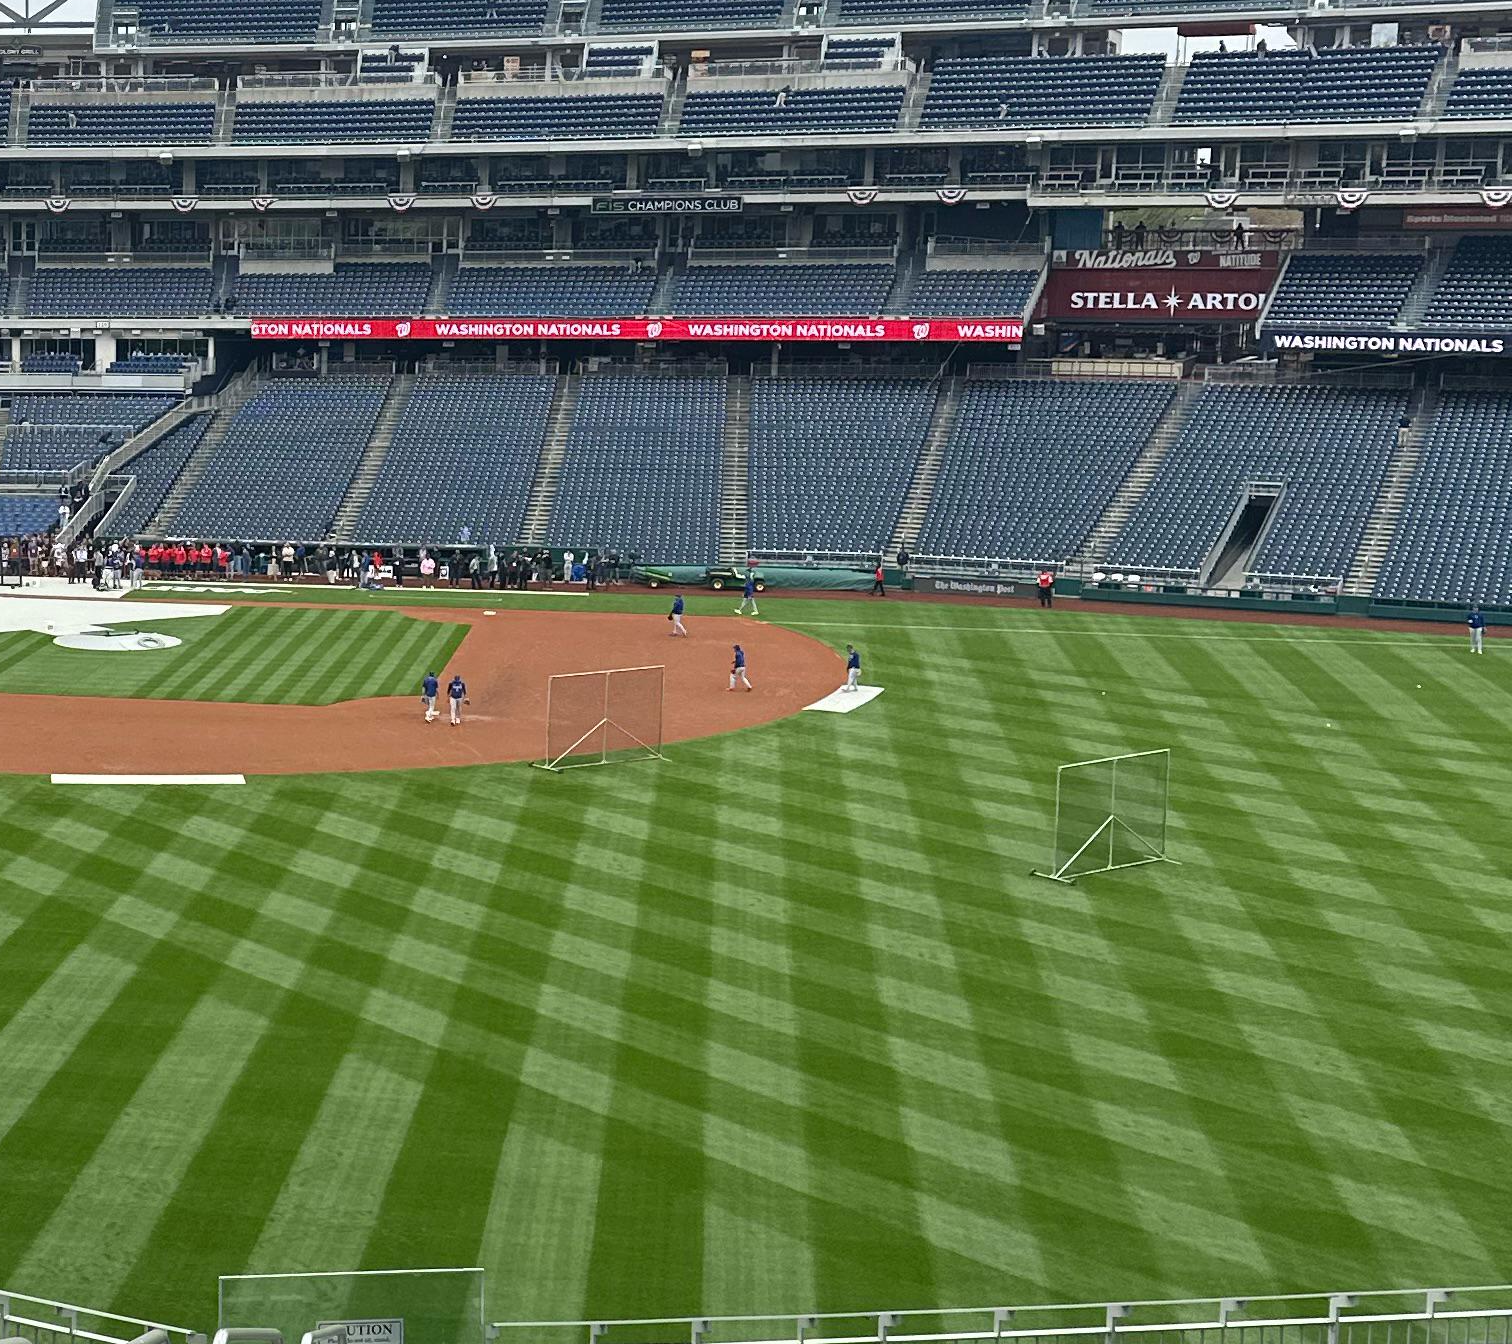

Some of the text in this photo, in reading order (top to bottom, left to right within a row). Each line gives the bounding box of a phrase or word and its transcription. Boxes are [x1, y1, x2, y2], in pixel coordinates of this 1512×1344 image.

[627, 200, 702, 211] CHAMPIONS
[704, 199, 739, 210] CLUB
[1074, 250, 1177, 269] Nationals
[1219, 253, 1262, 268] NATITUDE
[1070, 291, 1159, 310] STELLA
[251, 323, 372, 336] GTON NATIONALS
[435, 323, 621, 336] WASHINGTON NATIONALS
[687, 324, 885, 337] WASHINGTON NATIONALS
[956, 324, 1023, 338] WASHIN
[1274, 335, 1504, 353] WASHINGTON NATIONALS
[934, 580, 1015, 595] The Washington Post
